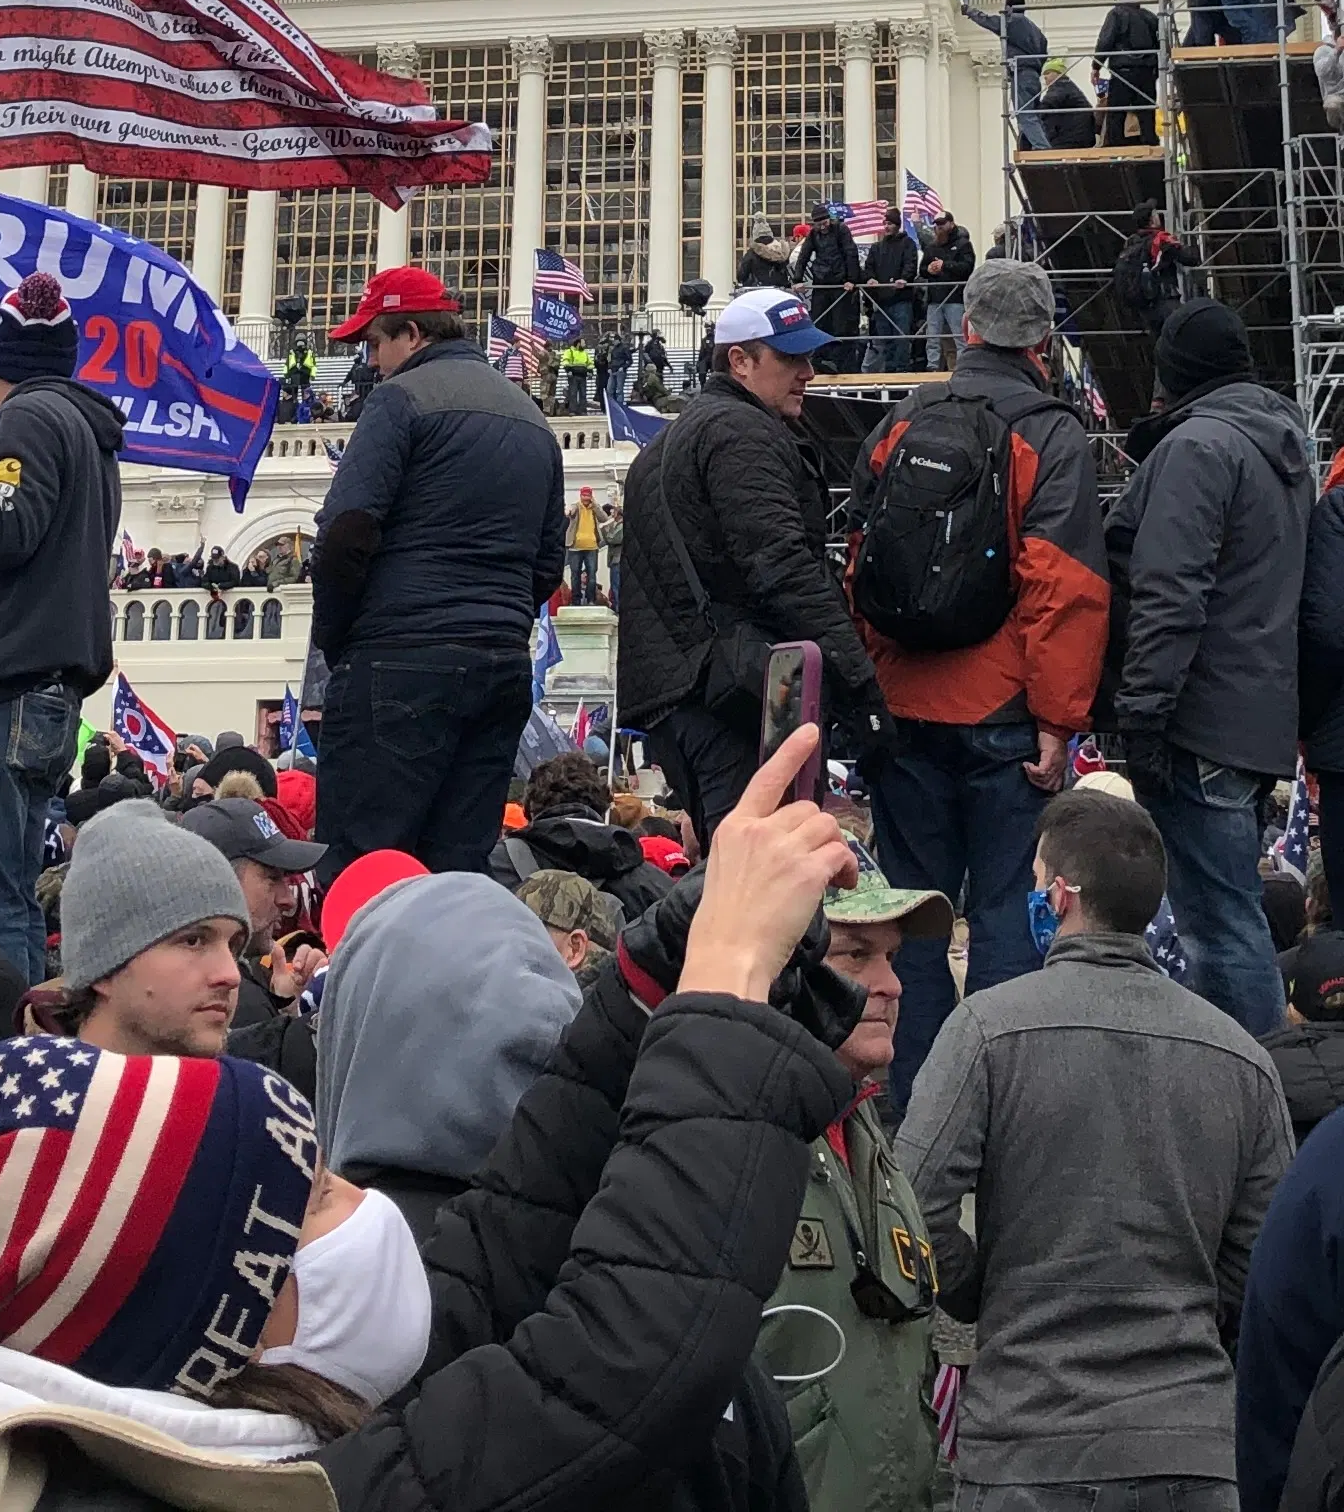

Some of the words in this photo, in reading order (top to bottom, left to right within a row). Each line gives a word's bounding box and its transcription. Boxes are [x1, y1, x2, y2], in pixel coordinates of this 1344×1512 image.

[13, 44, 76, 70] might
[84, 46, 160, 83] Attempt
[179, 74, 234, 95] abuse
[0, 103, 67, 129] Their
[71, 113, 112, 135] own
[118, 119, 227, 148] government.
[243, 132, 320, 158] George
[170, 1183, 303, 1397] REAT
